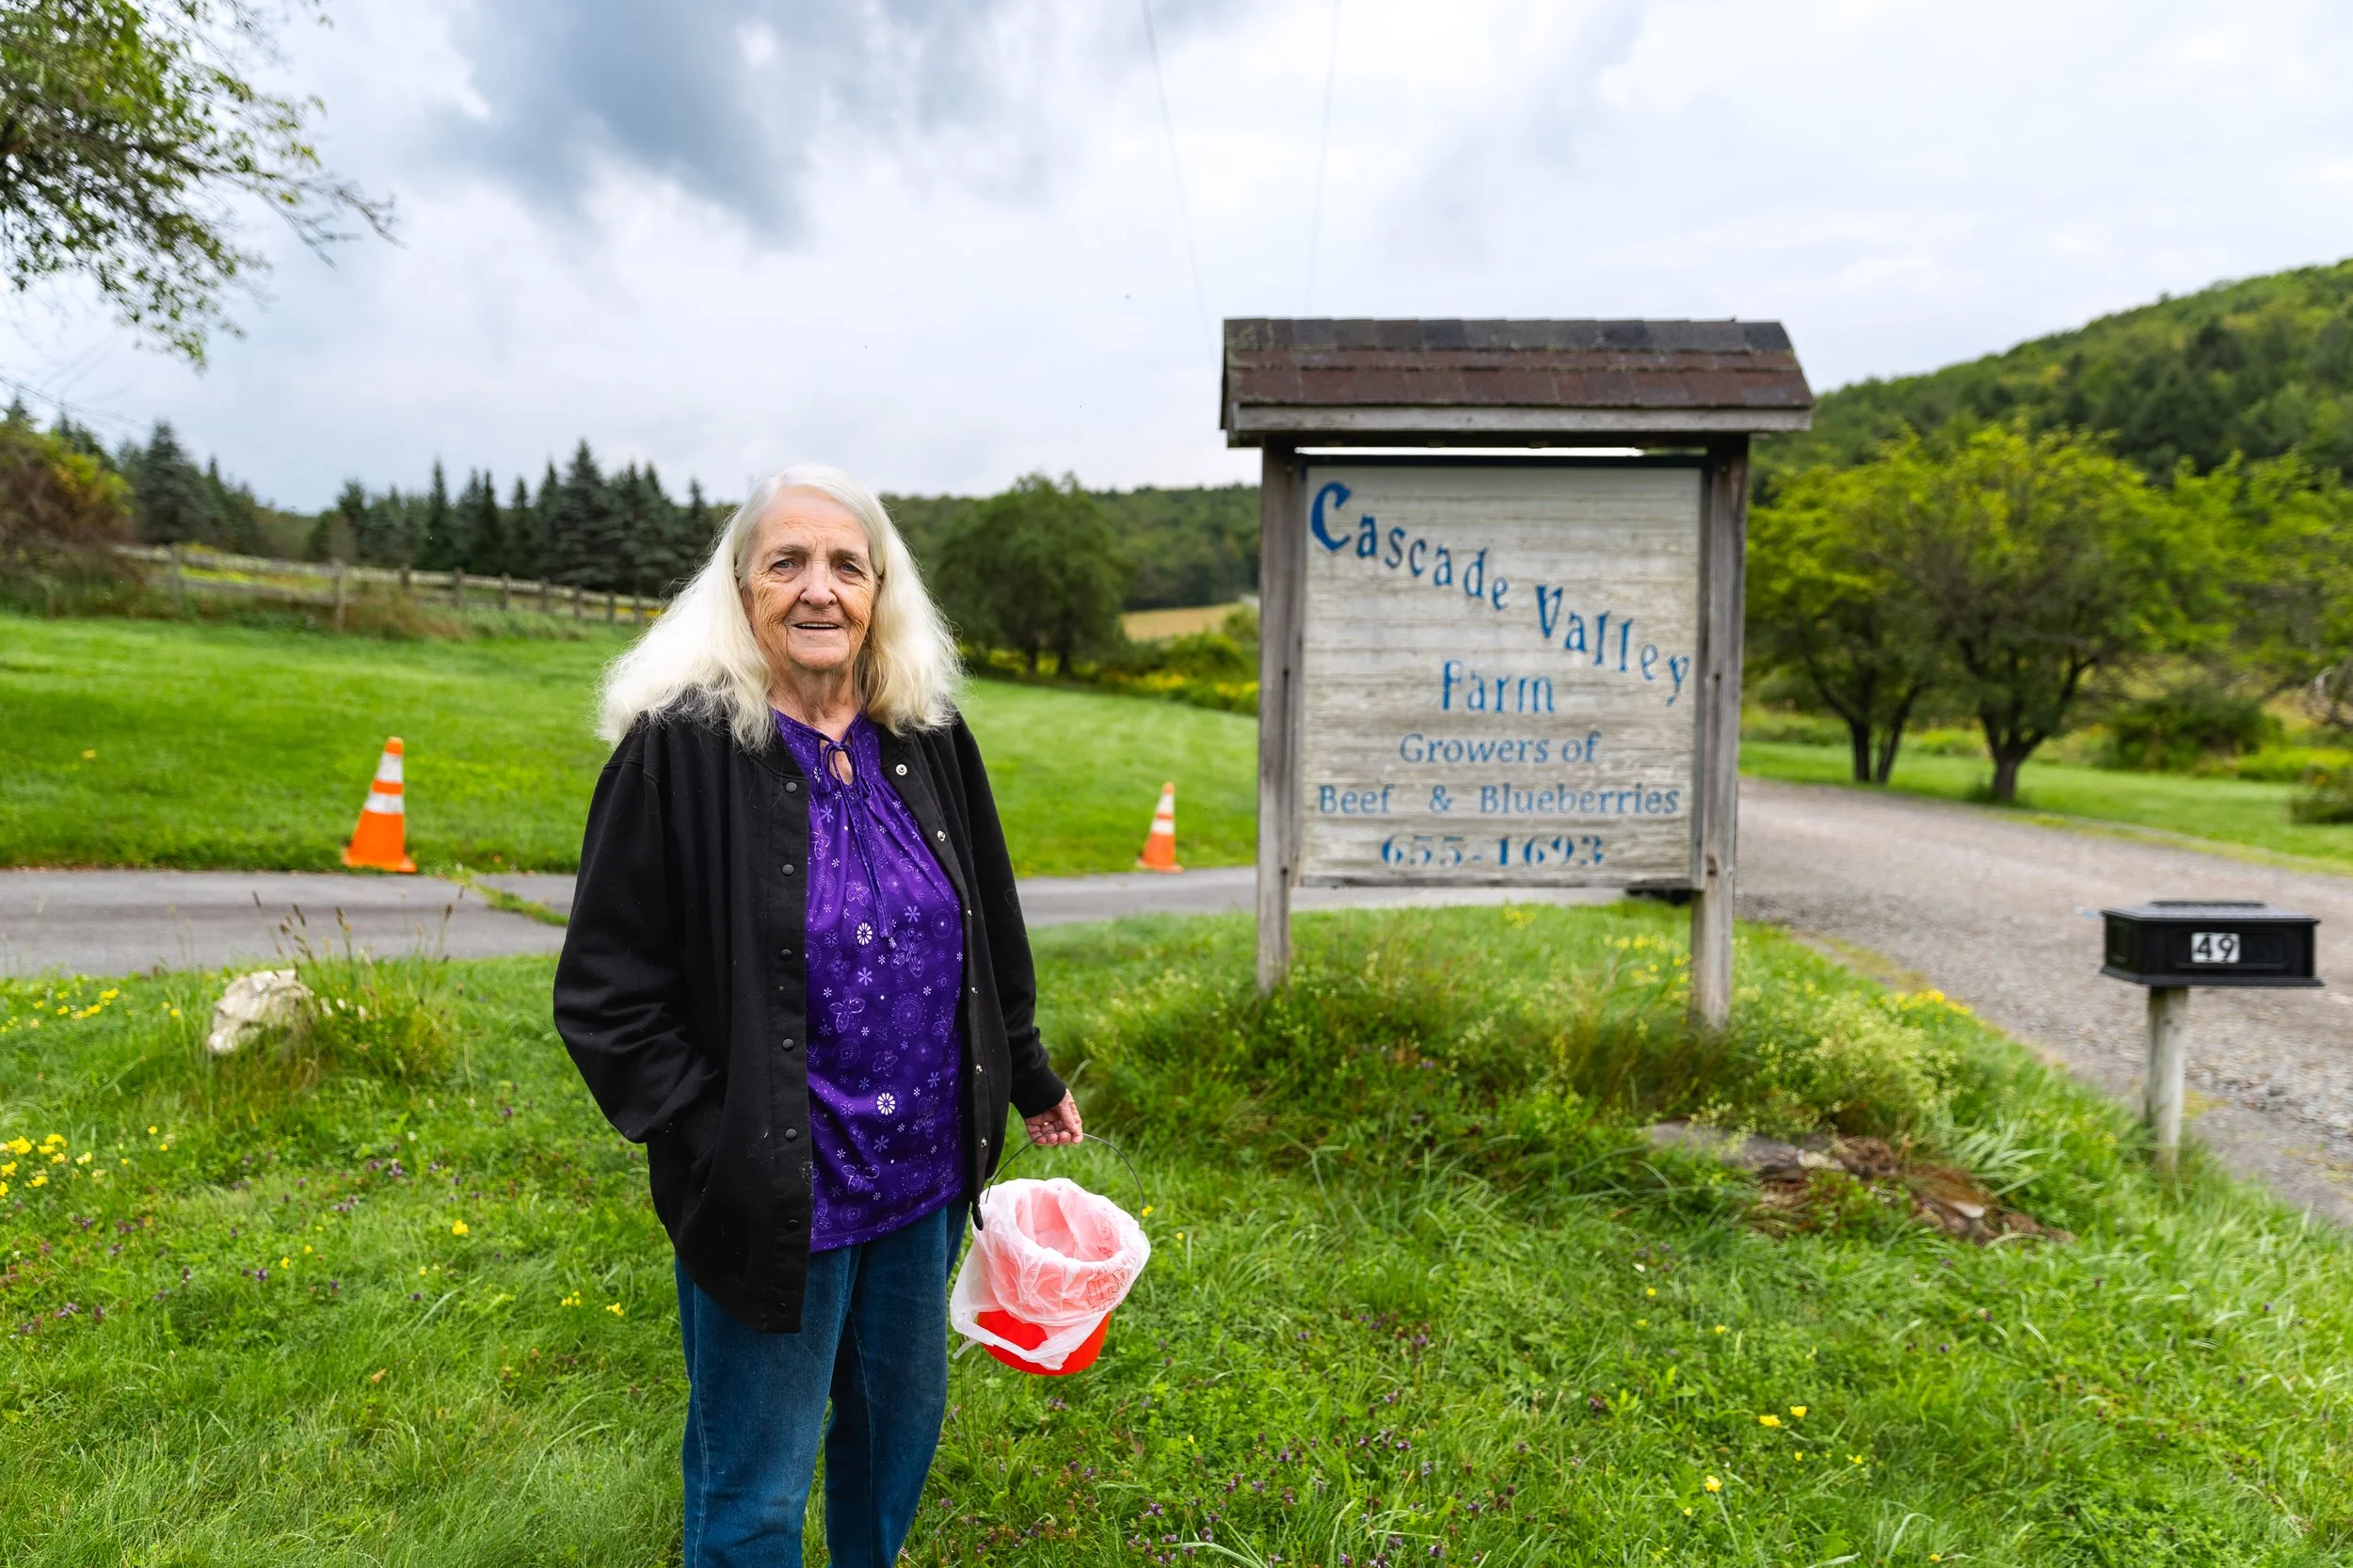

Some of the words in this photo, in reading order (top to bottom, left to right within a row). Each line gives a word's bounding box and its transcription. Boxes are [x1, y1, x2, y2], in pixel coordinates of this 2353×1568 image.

[1310, 481, 1510, 611] Cascade
[1536, 584, 1690, 708] Valley
[1442, 660, 1556, 714] Farm
[1400, 732, 1550, 764] Growers
[1561, 730, 1602, 764] of
[1319, 783, 1397, 815] Beef
[1429, 784, 1454, 815] &
[1480, 782, 1681, 815] Blueberries
[1381, 834, 1604, 868] 655-1693
[2194, 935, 2234, 960] 49
